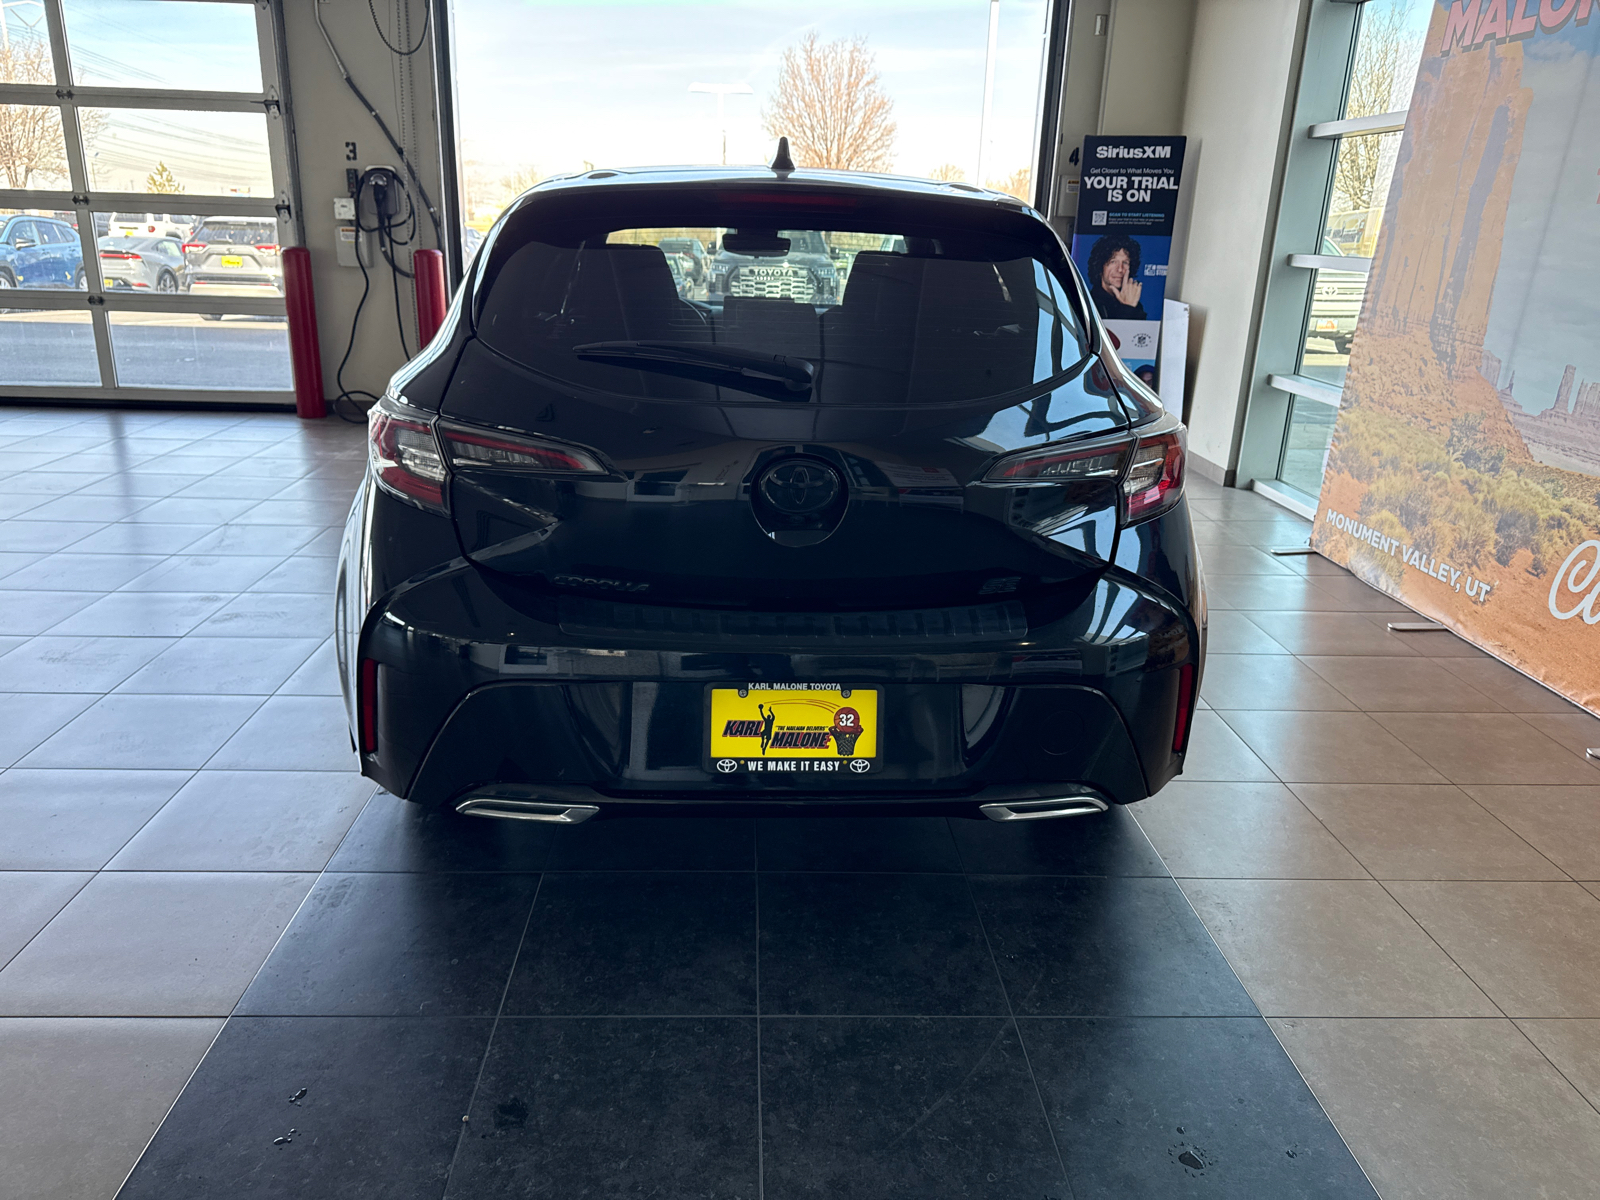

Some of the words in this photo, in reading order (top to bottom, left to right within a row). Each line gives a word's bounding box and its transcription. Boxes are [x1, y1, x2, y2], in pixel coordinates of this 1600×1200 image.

[345, 141, 357, 161] 3
[1069, 147, 1080, 166] 4
[1096, 146, 1171, 158] SiriusXM
[1084, 176, 1127, 189] YOUR
[1131, 176, 1178, 189] TRIAL
[1107, 189, 1123, 202] IS
[1126, 189, 1151, 202] ON
[1326, 508, 1399, 557] MONUMENT
[1402, 544, 1462, 592] VALLEY,
[1465, 576, 1490, 602] UT
[839, 714, 854, 727] 32
[722, 720, 764, 737] KARL
[770, 732, 832, 749] MALONE
[747, 761, 763, 771] WE
[767, 761, 797, 771] MAKE
[800, 761, 810, 771] IT
[813, 761, 840, 771] EASY
